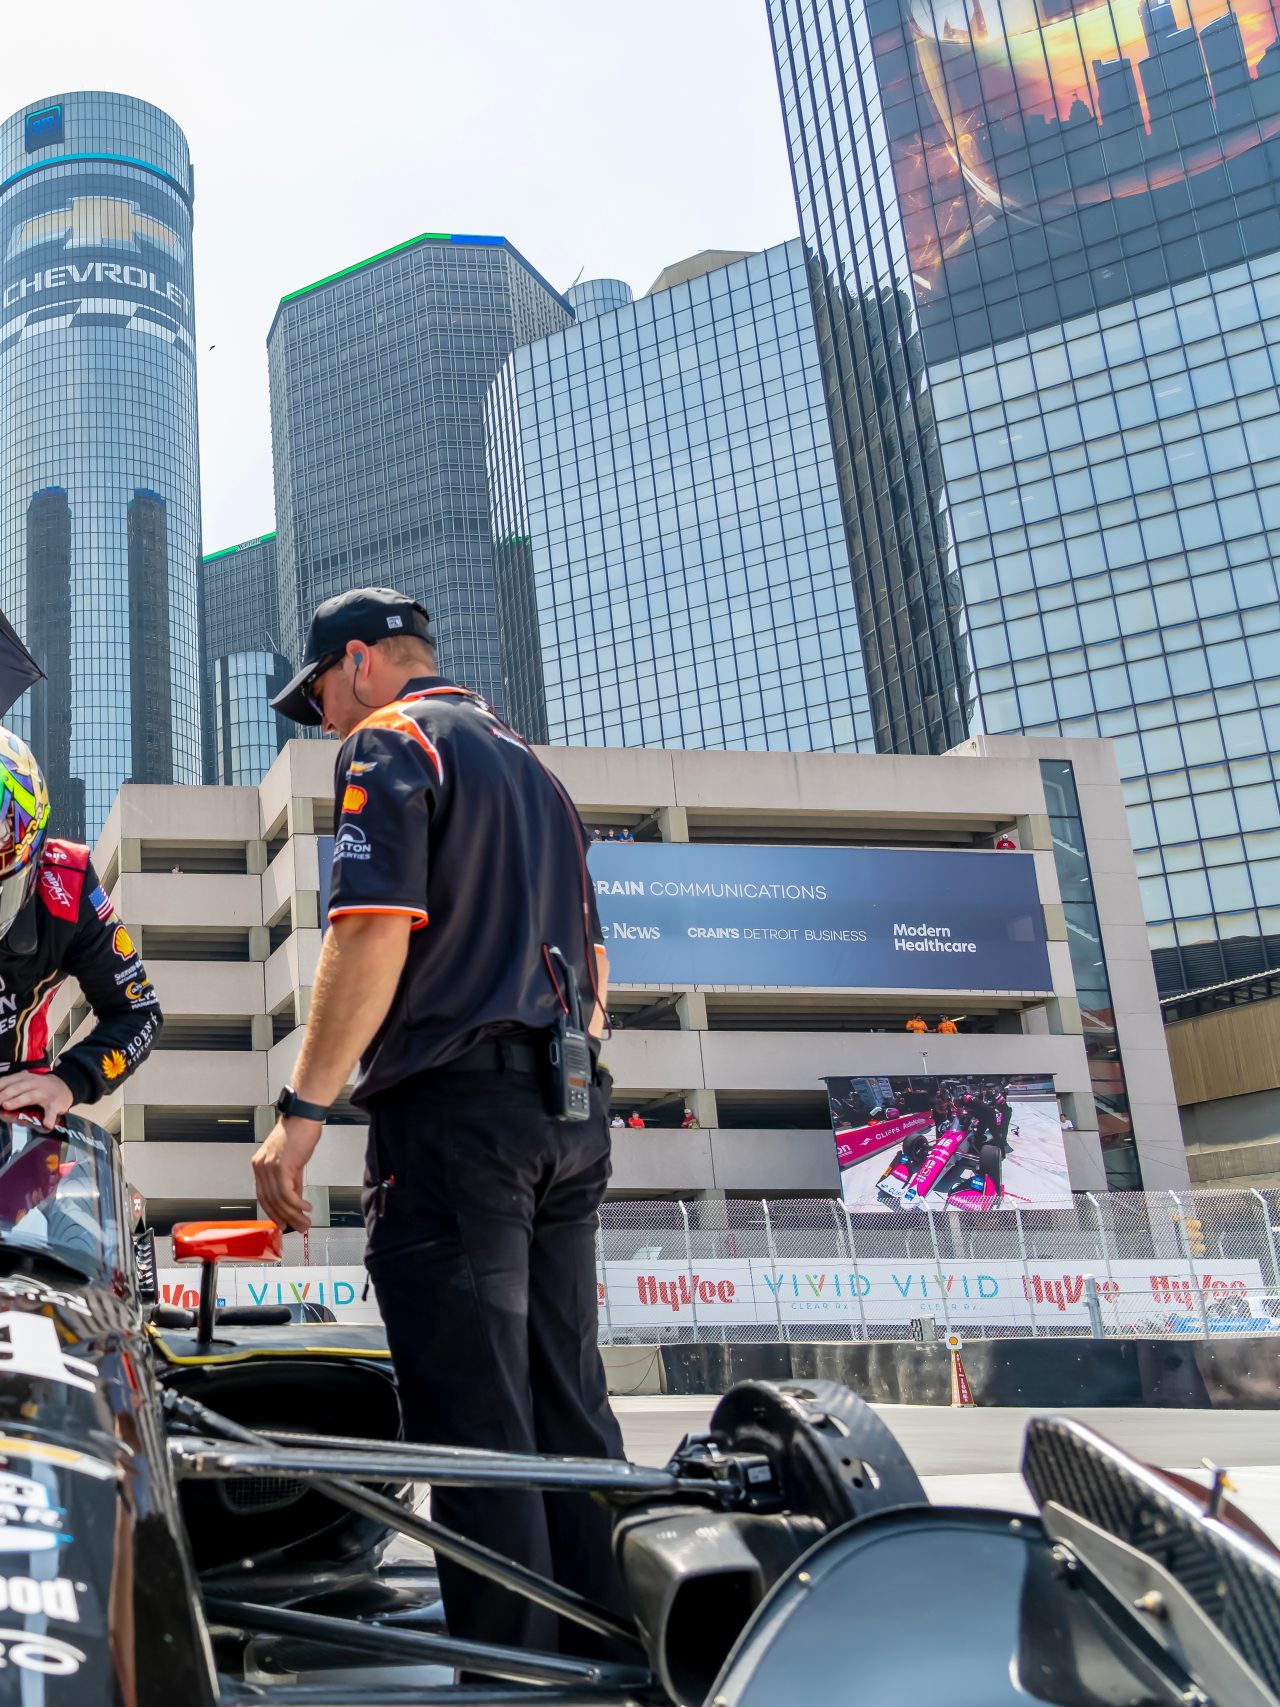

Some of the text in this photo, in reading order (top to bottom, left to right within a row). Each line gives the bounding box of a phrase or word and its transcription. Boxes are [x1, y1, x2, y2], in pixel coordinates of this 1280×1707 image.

[43, 871, 71, 908] IMPACT
[596, 880, 827, 900] RAIN COMMUNICATIONS
[612, 922, 661, 940] News
[687, 927, 867, 942] CRAIN'S DETROIT BUSINESS
[893, 923, 951, 938] Modern
[894, 938, 977, 953] Healthcare
[247, 1282, 355, 1305] VIVID
[637, 1275, 736, 1312] HyVee
[763, 1273, 871, 1298] VIVID
[892, 1274, 999, 1298] VIVID
